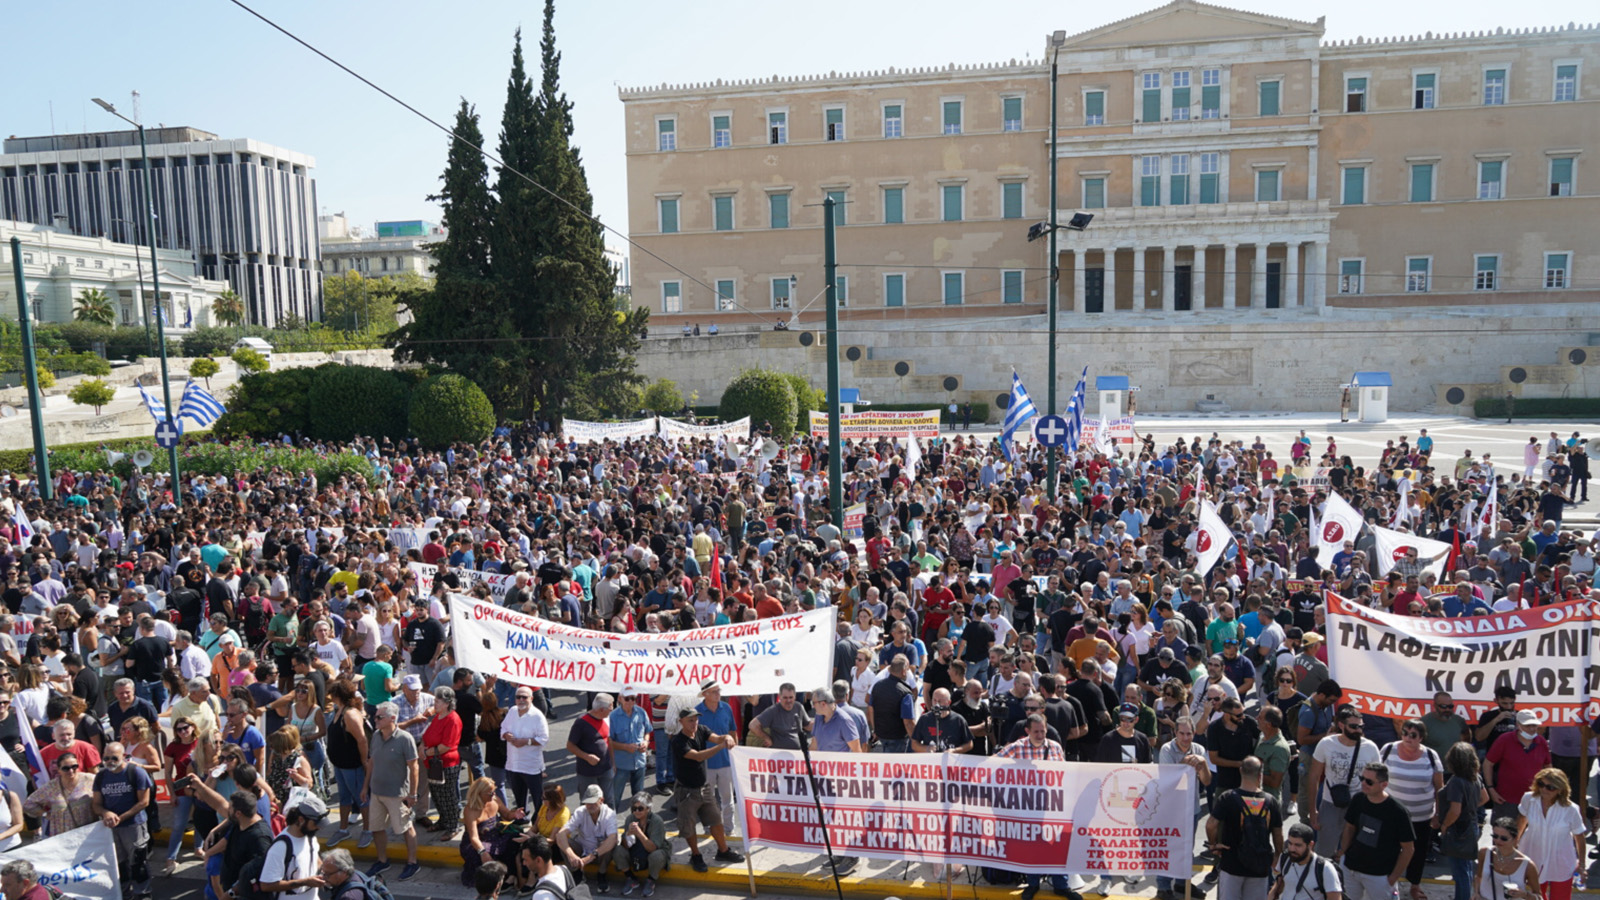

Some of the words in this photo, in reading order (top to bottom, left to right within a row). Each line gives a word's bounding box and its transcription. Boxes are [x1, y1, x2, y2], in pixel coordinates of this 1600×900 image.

[683, 622, 761, 642] ΑΝΑΤΡΟΠΗ
[771, 615, 805, 632] ΤΟΥΣ
[1338, 621, 1370, 651] ΤΑ
[1377, 632, 1527, 664] ΑΦΕΝΤΙΚΑ
[506, 630, 549, 651] ΚΑΜΙΑ
[655, 643, 736, 660] ΑΝΑΠΤΥΞΗ
[743, 638, 780, 656] ΤΟΥΣ
[499, 655, 596, 683] ΣΥΝΔΙΚΑΤΟ
[610, 660, 666, 685] ΤΥΠΟΥ
[675, 663, 746, 687] ΧΑΡΤΟΥ
[1426, 668, 1455, 692] ΚΙ
[1464, 670, 1485, 694] Ο
[1495, 667, 1575, 697] ΛΑΟΣ
[748, 758, 857, 777] ΑΠΟΡΡΙΠΤΟΥΜΕ
[860, 762, 879, 778] ΤΗ
[882, 763, 943, 780] ΔΟΥΛΕΙΑ
[947, 766, 991, 784] ΜΕΧΡΙ
[995, 767, 1064, 787] ΘΑΝΑΤΟΥ
[750, 773, 779, 794] ΓΙΑ
[784, 774, 808, 796] ΤΑ
[815, 778, 876, 800] ΚΕΡΔΗ
[881, 780, 920, 801] ΤΩΝ
[926, 783, 1064, 812] ΒΙΟΜΗΧΑΝΩΝ
[752, 803, 776, 821] ΟΧΙ
[779, 805, 821, 824] ΣΤΗΝ
[823, 808, 914, 831] ΚΑΤΑΡΓΗΣΗ
[917, 814, 948, 833] ΤΟΥ
[952, 816, 1064, 842] ΠΕΝΘΗΜΕΡΟΥ
[1077, 827, 1181, 838] ΟΜΟΣΠΟΝΔΙΑ
[803, 826, 831, 844] ΚΑΙ
[834, 829, 864, 847] ΤΗΣ
[867, 831, 947, 853] ΚΥΡΙΑΚΗΣ
[951, 835, 1007, 858] ΑΡΓΙΑΣ
[1086, 849, 1170, 860] ΤΡΟΦΙΜΩΝ
[1089, 838, 1168, 848] ΓΑΛΑΚΤΟΣ
[1086, 860, 1113, 871] ΚΑΙ
[1117, 861, 1170, 872] ΠΟΤΩΝ
